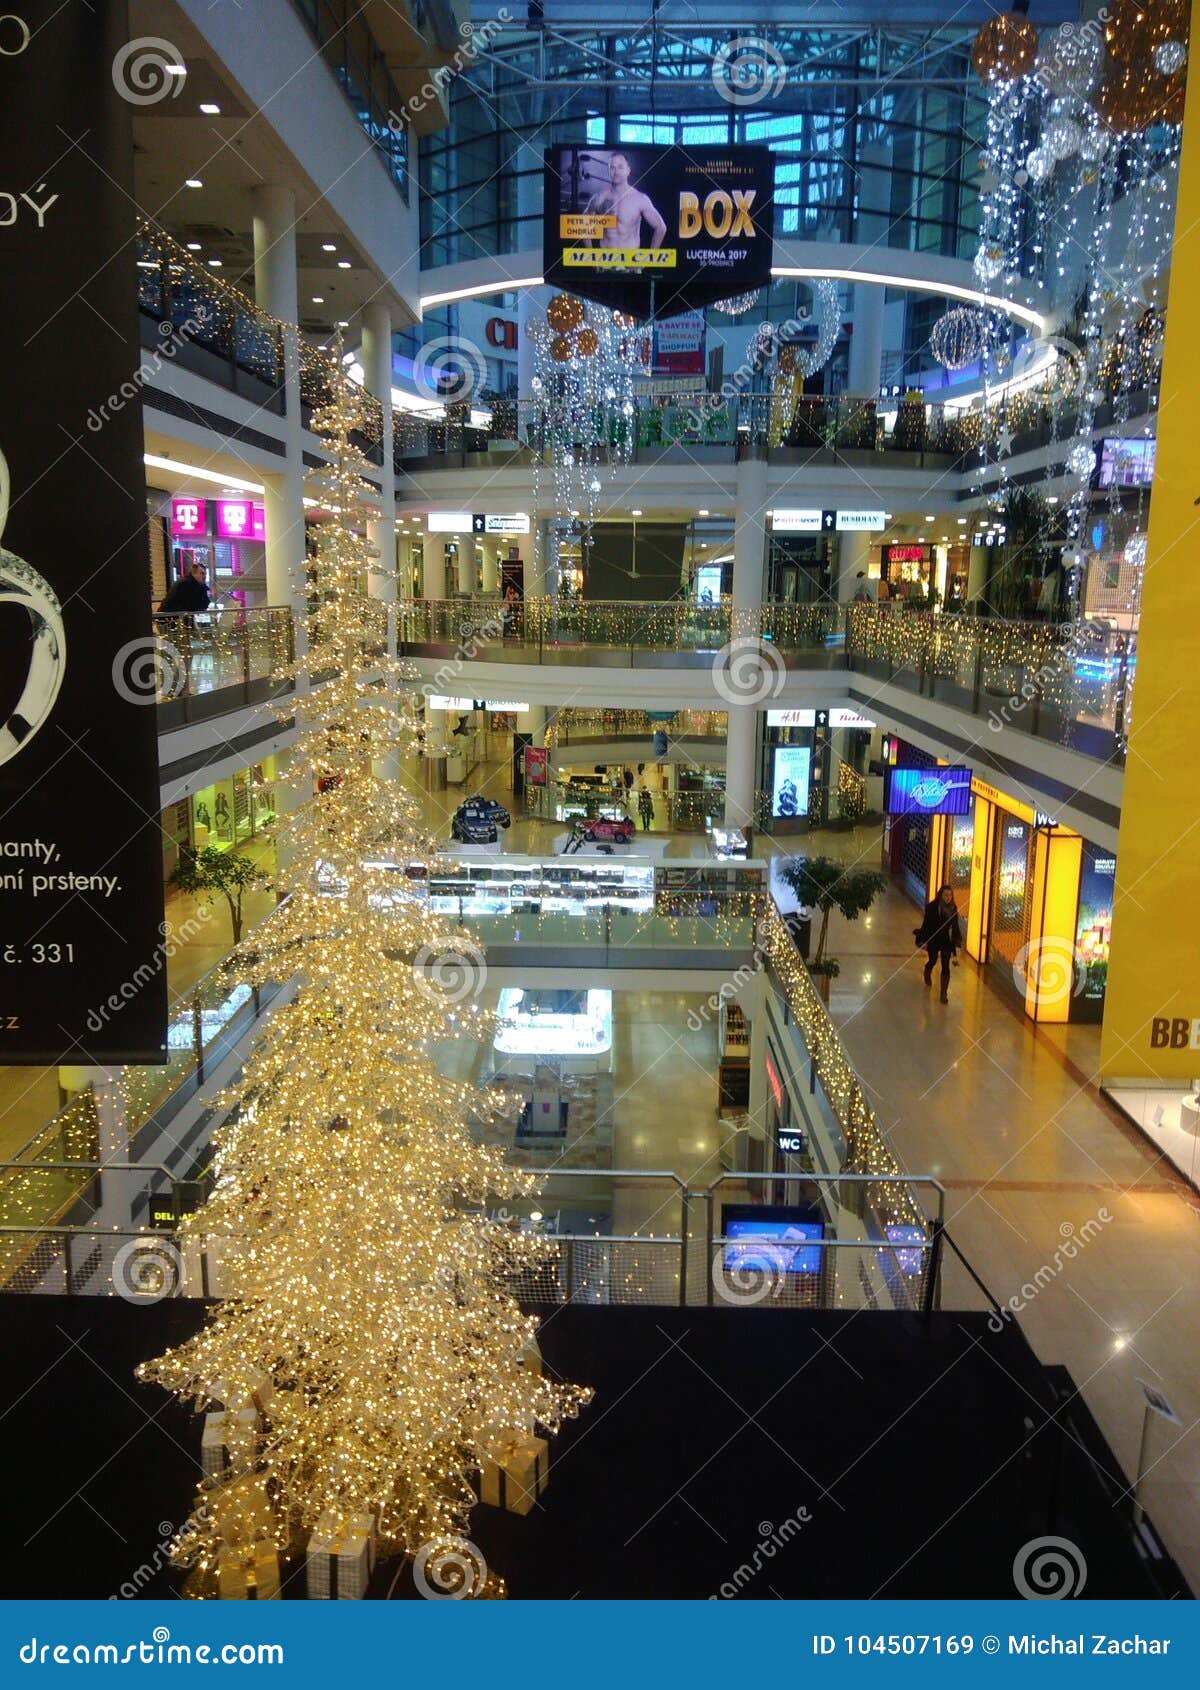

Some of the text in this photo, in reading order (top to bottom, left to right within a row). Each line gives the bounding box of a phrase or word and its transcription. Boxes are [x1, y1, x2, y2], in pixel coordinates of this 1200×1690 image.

[679, 189, 757, 239] BOX
[686, 249, 748, 260] LUCERNA 2017
[840, 515, 878, 523] BUSHMAN
[0, 838, 61, 865] anty,
[32, 872, 123, 898] prsteny.
[3, 943, 75, 964] č. 331
[778, 1137, 801, 1151] WC
